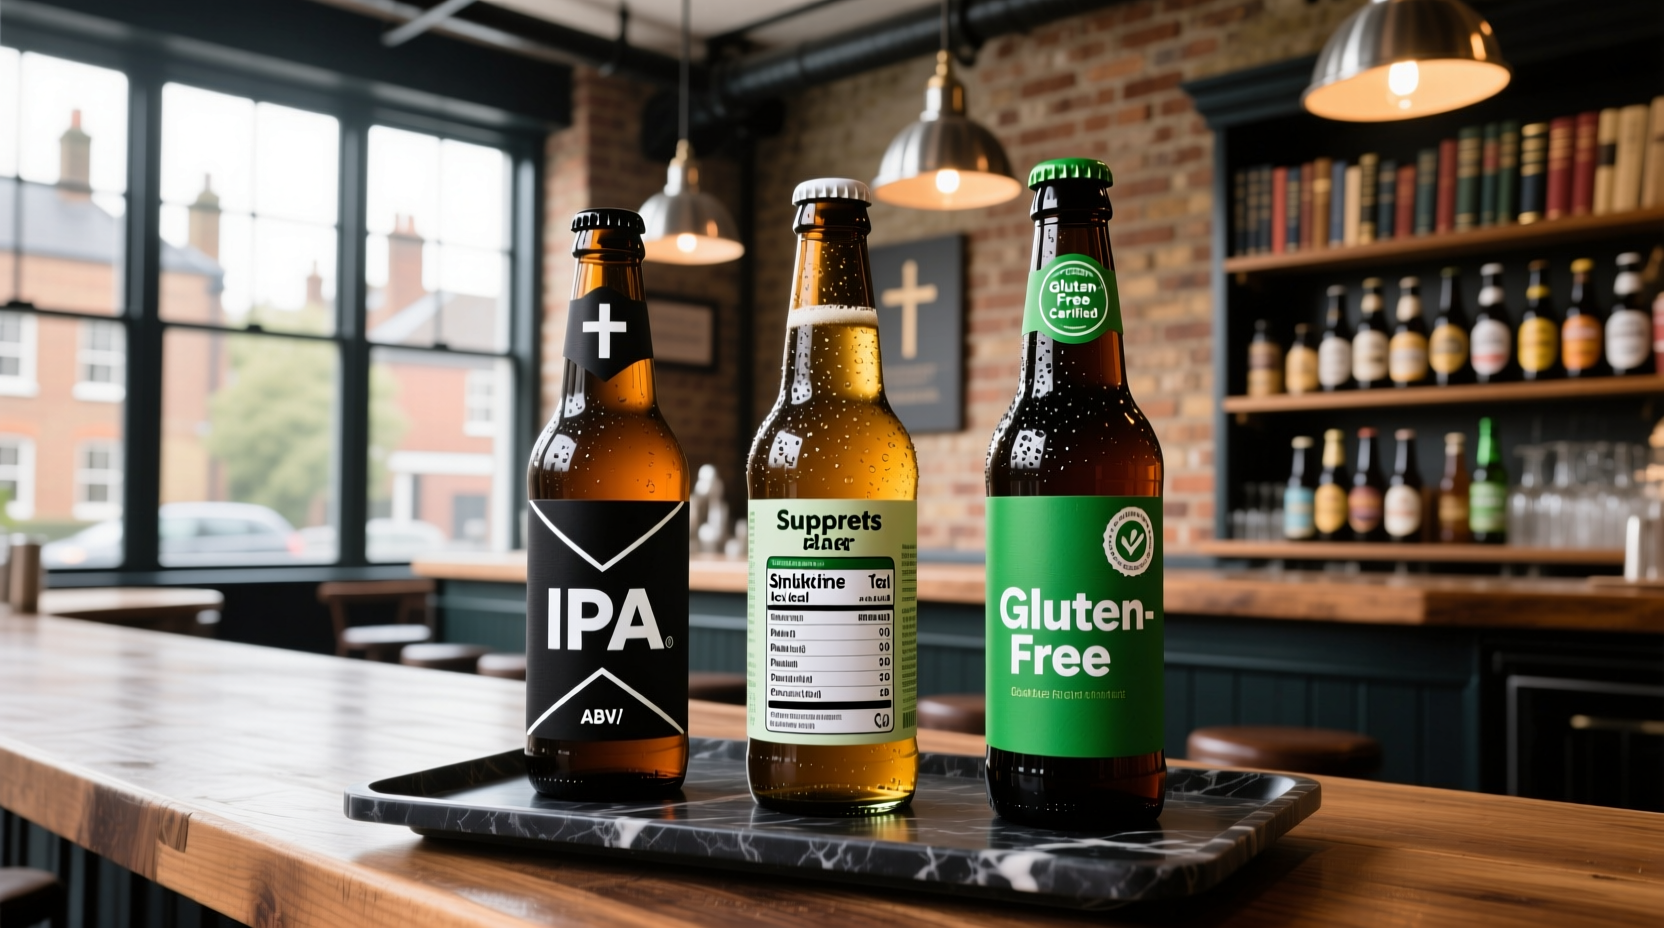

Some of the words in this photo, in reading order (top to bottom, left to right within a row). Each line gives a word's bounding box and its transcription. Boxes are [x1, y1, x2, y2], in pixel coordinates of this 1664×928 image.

[1049, 279, 1097, 293] Gluten
[776, 509, 882, 536] Supprets
[548, 587, 665, 651] IPA
[999, 586, 1155, 632] Gluten-
[1010, 633, 1111, 678] Free
